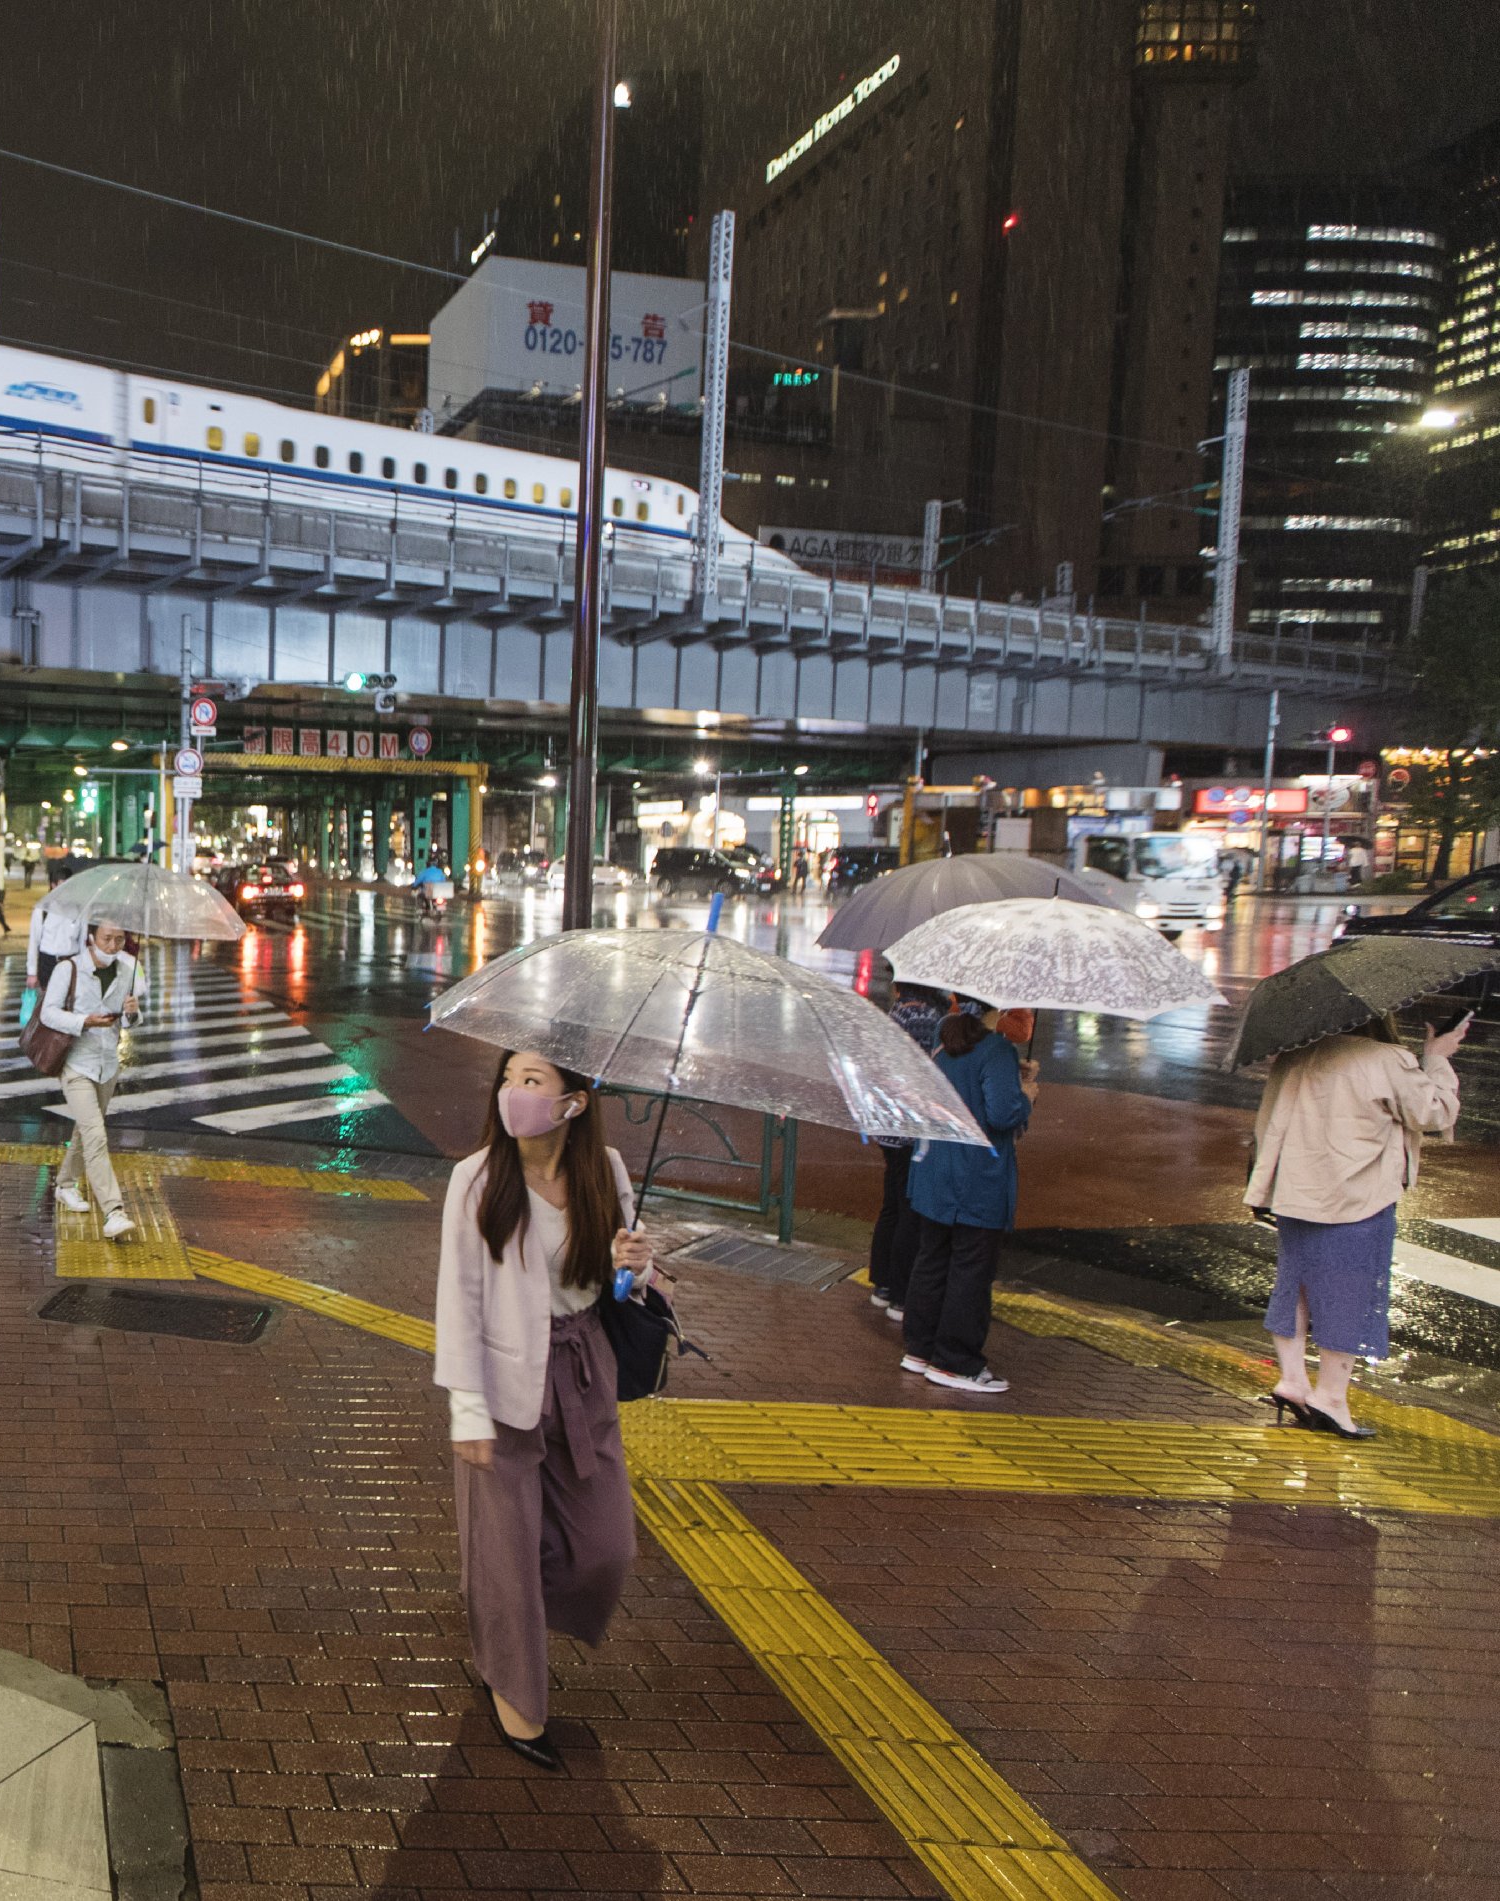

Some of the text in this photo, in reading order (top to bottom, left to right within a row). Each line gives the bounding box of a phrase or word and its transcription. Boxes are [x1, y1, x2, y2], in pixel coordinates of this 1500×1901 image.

[814, 92, 855, 143] HOTEL
[853, 54, 900, 105] TOKYO
[524, 325, 668, 365] 0120-5-787
